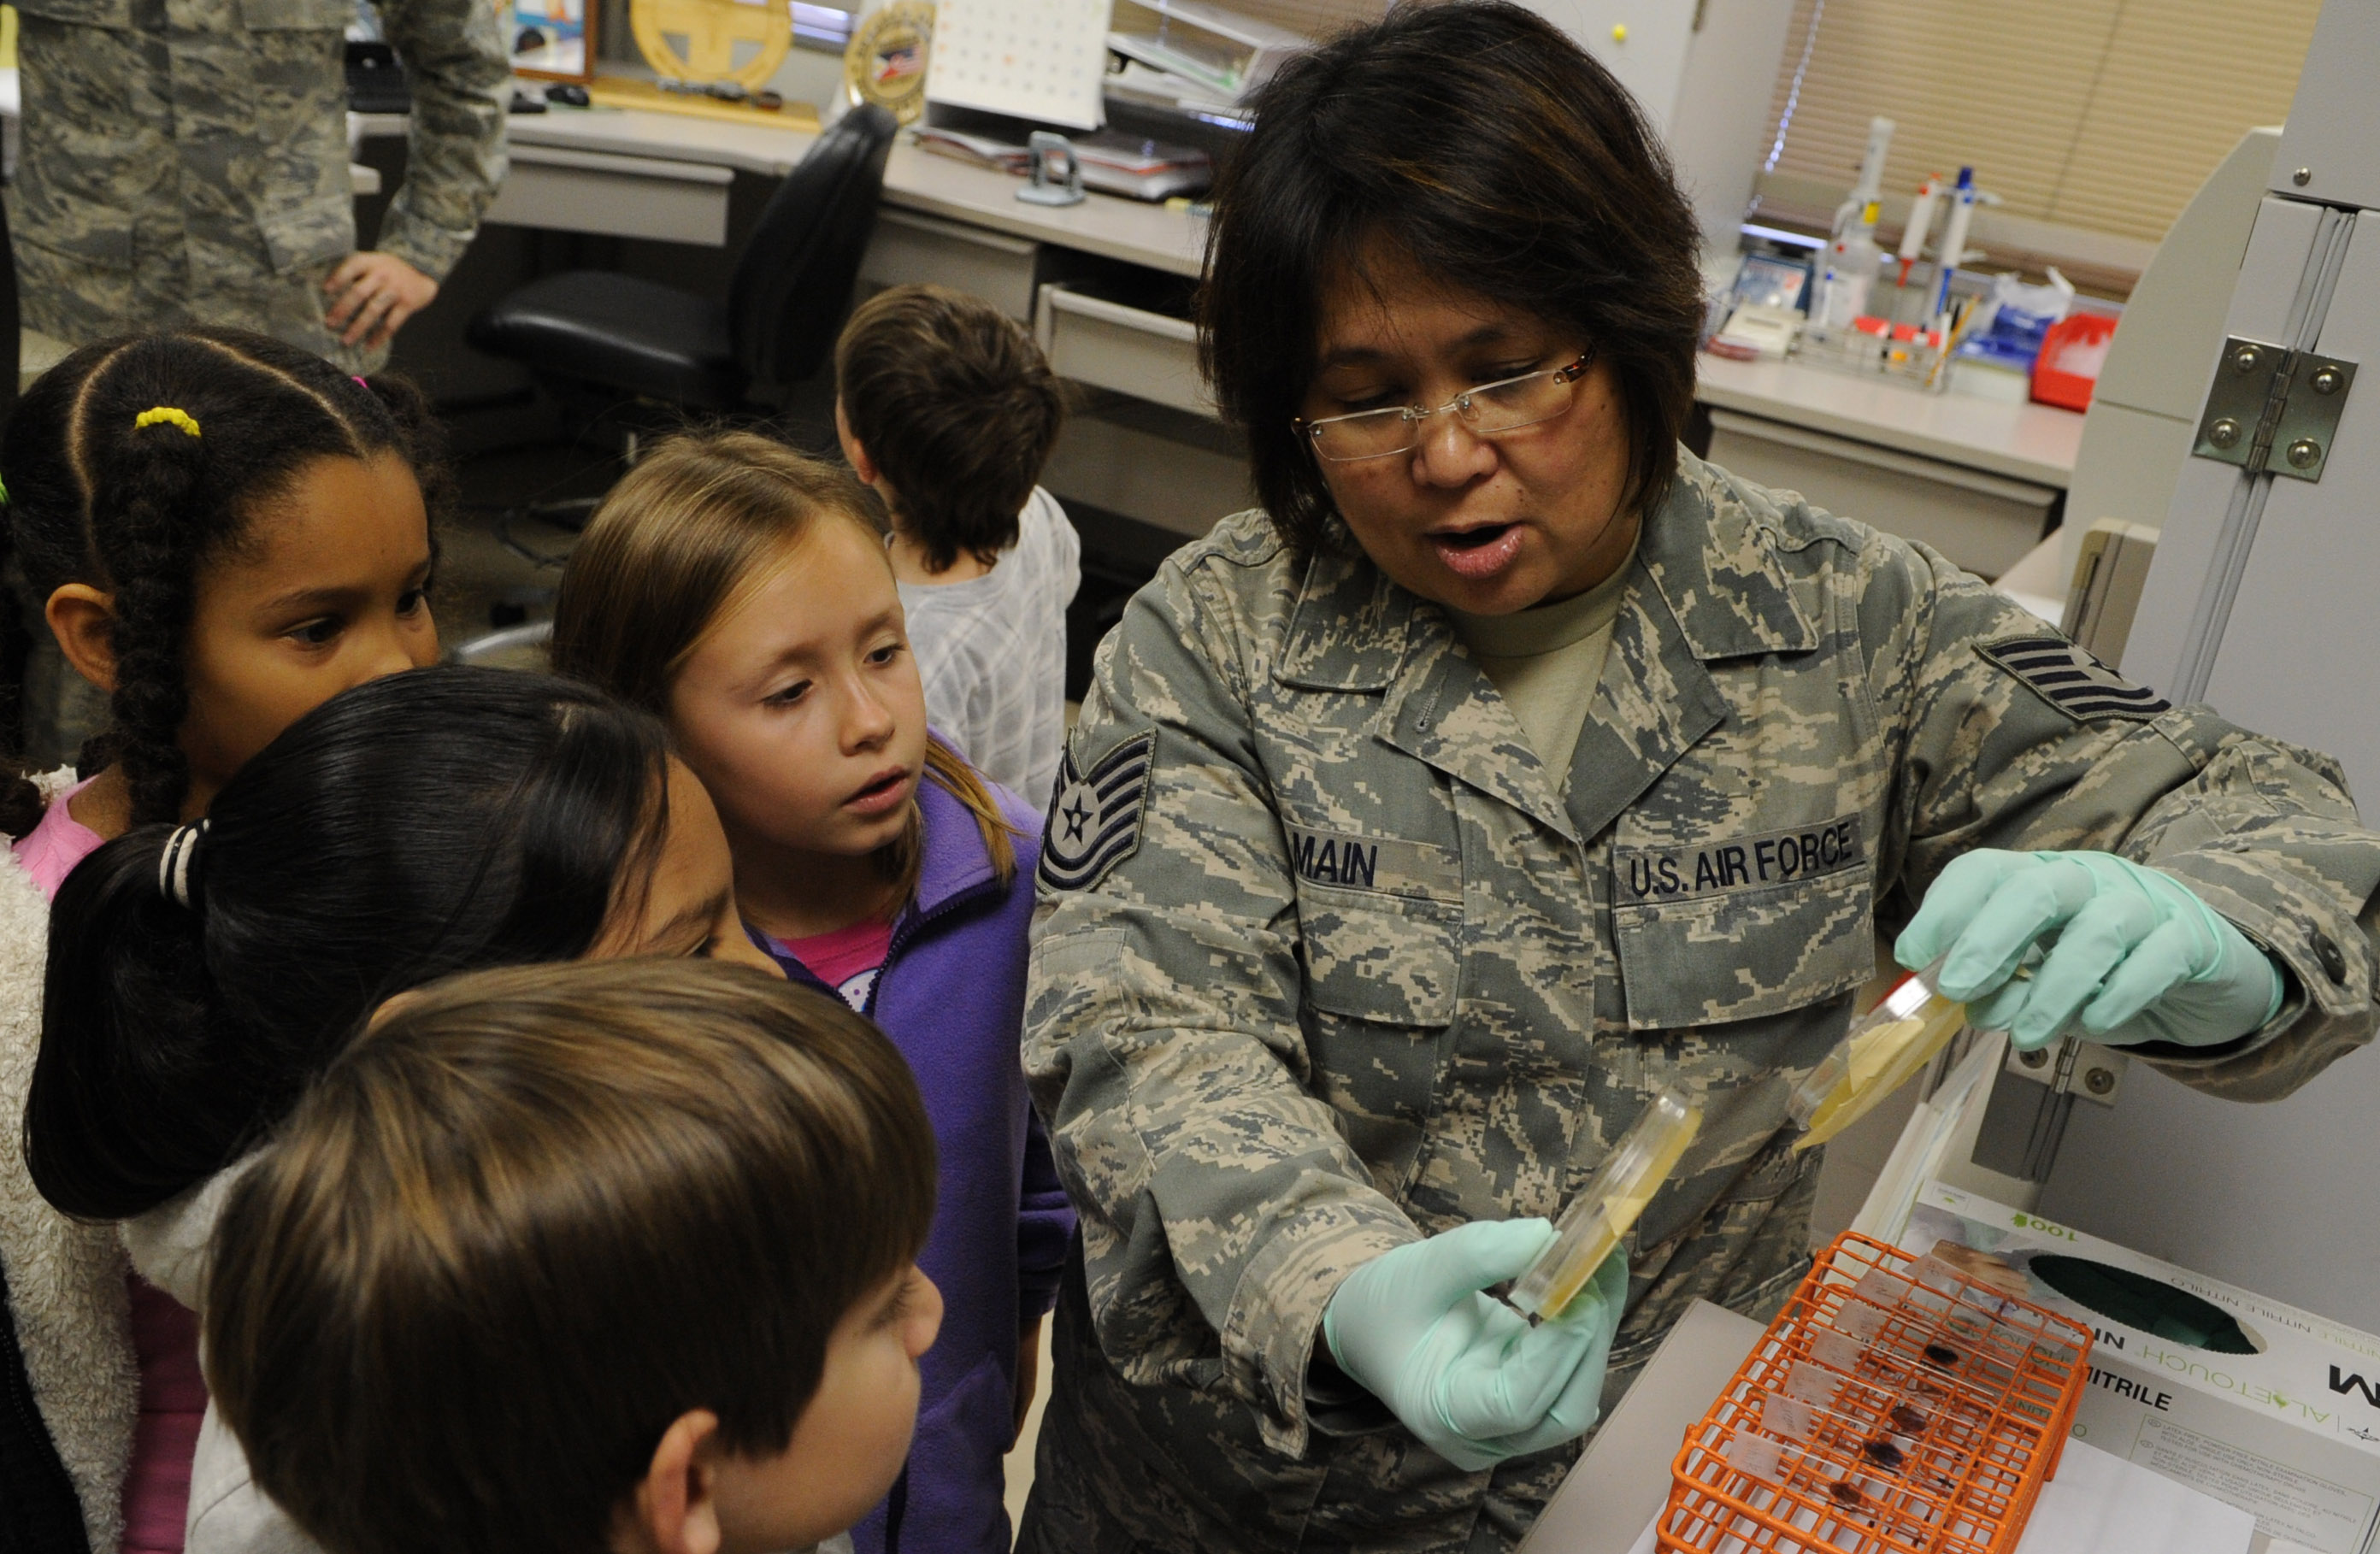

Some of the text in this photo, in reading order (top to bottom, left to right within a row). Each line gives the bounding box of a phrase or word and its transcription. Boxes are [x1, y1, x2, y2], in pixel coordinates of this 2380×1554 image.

[1293, 832, 1378, 887] MAIN
[1630, 822, 1853, 897] U.S. AIR FORCE
[2030, 1219, 2078, 1242] 100
